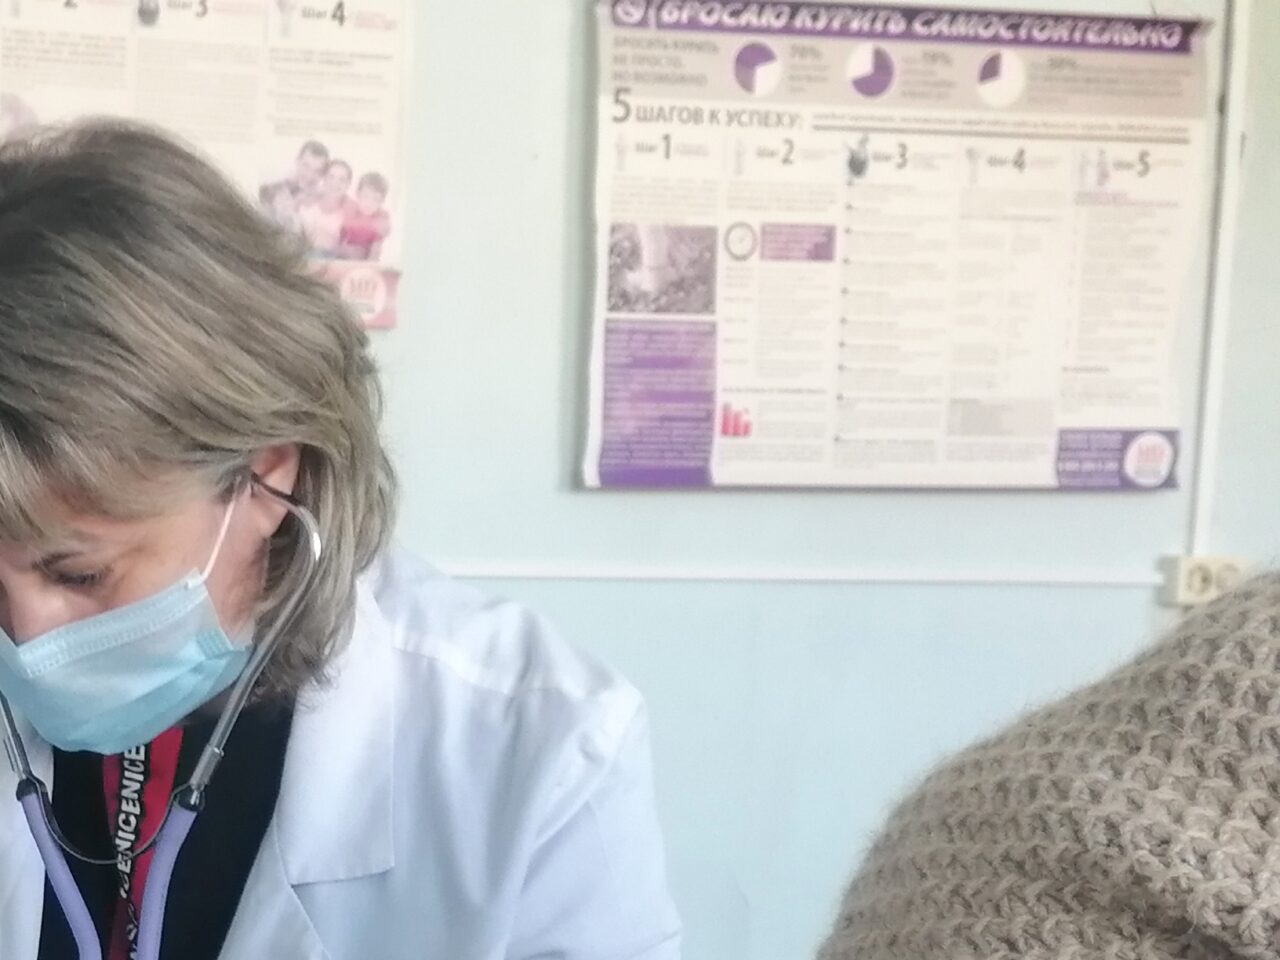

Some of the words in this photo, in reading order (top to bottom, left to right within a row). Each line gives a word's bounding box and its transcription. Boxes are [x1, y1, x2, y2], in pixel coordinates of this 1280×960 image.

[331, 1, 346, 27] 4
[794, 4, 907, 34] КУРИТЬ
[912, 10, 1183, 47] САМОСТОЯТЕЛЬНО
[612, 87, 631, 123] 5
[635, 105, 704, 124] ШАГОВ
[709, 107, 721, 126] К
[662, 134, 671, 160] 1
[781, 139, 794, 165] 2
[896, 142, 907, 169] 3
[1011, 148, 1026, 173] 4
[1137, 150, 1150, 178] 5
